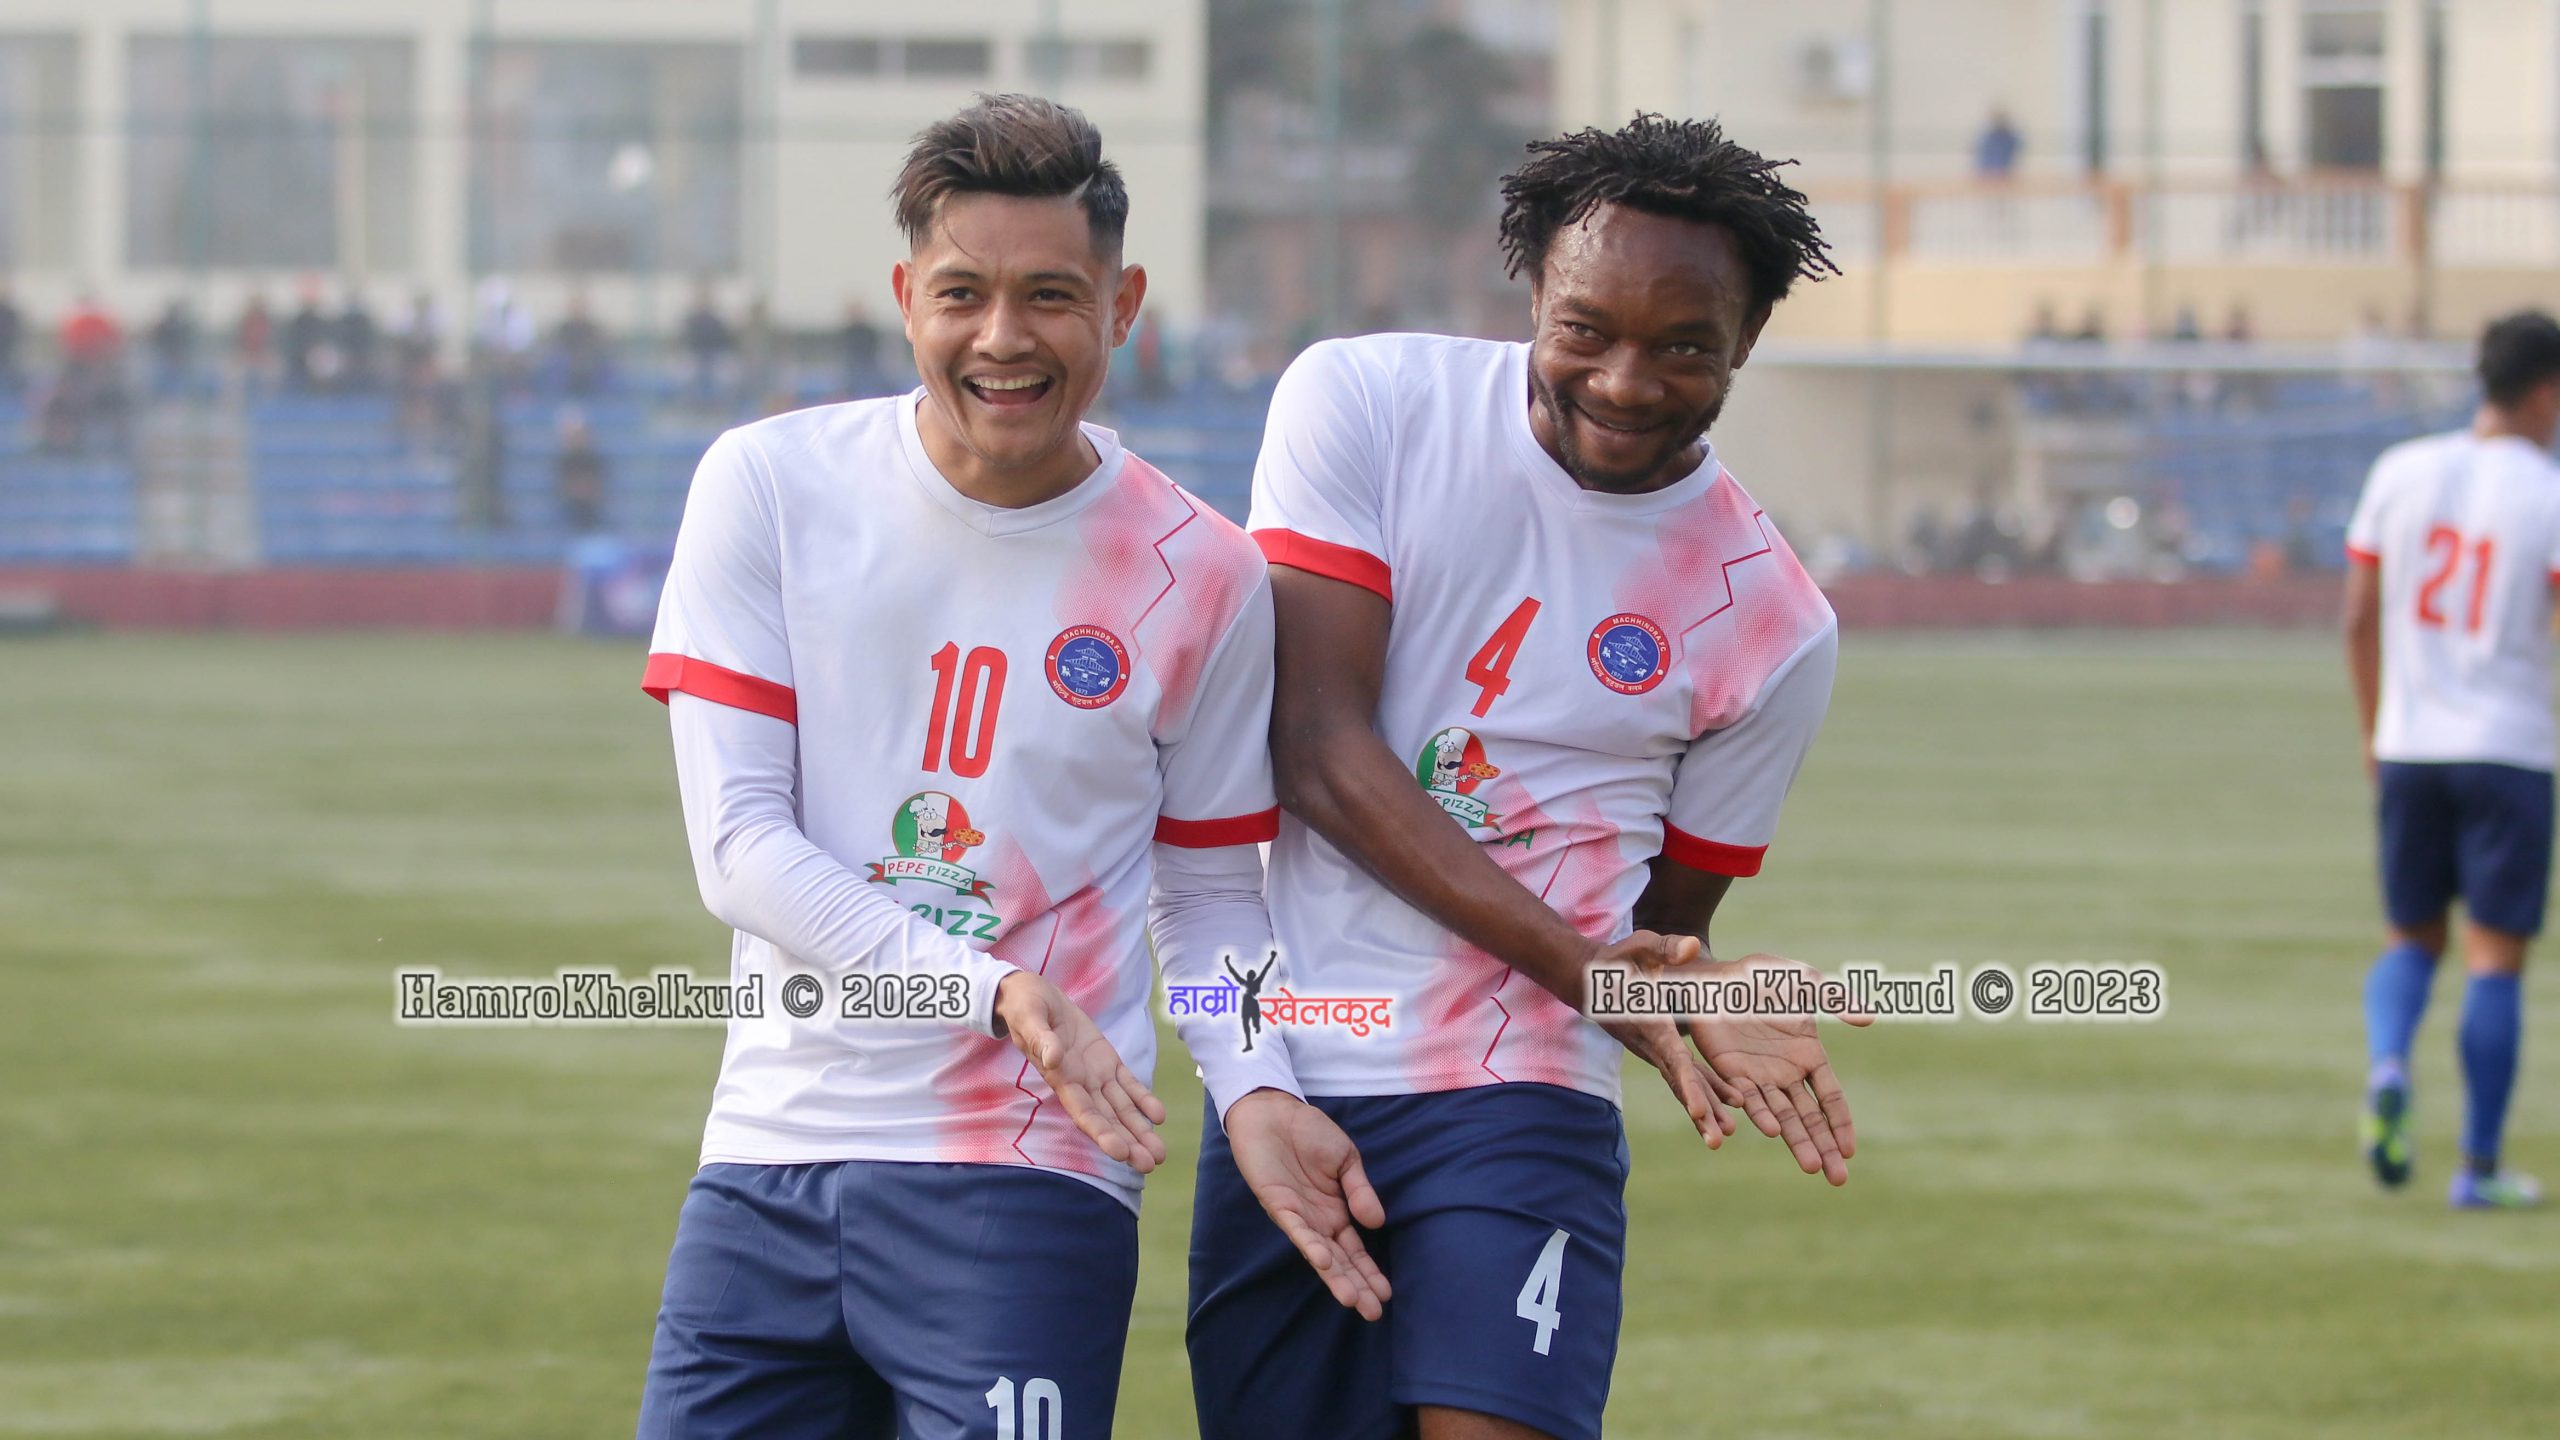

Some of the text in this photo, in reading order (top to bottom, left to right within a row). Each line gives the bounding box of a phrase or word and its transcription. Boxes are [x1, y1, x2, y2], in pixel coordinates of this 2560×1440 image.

[1612, 616, 1667, 652] MACHHINDRA FC
[2417, 527, 2493, 635] 21
[1062, 628, 1123, 656] MACHHINDRA FC
[1465, 596, 1542, 719] 4
[921, 640, 1009, 779] 10
[1516, 1228, 1571, 1357] 4
[984, 1375, 1063, 1440] 10
